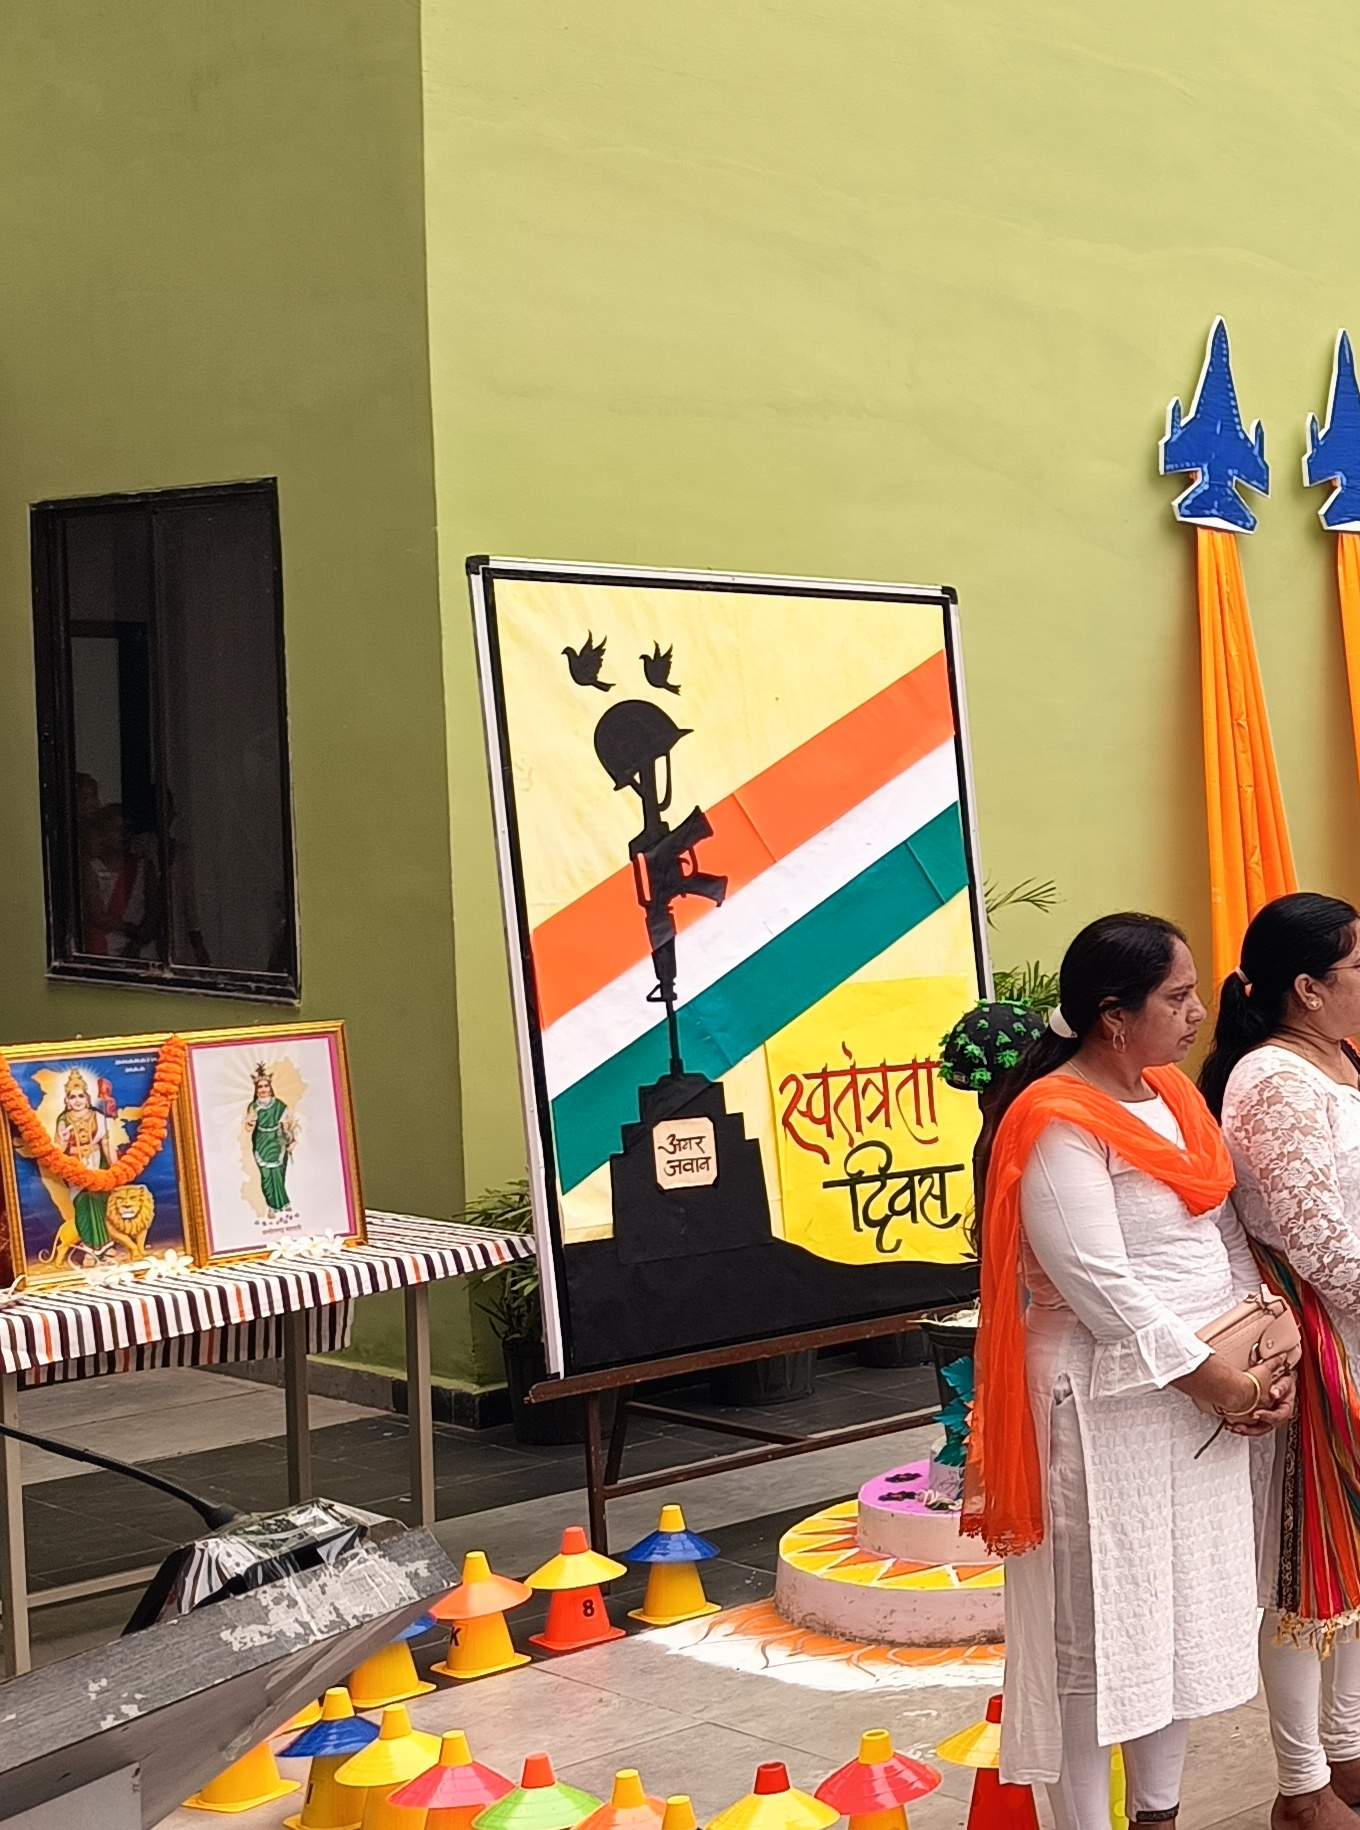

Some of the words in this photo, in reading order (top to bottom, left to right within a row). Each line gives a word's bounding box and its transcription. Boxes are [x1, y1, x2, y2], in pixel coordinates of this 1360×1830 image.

[779, 1041, 942, 1165] स्वतंत्रता
[663, 1156, 712, 1177] जवान
[822, 1140, 965, 1254] दिवस
[582, 1599, 595, 1617] 8
[450, 1626, 461, 1647] K
